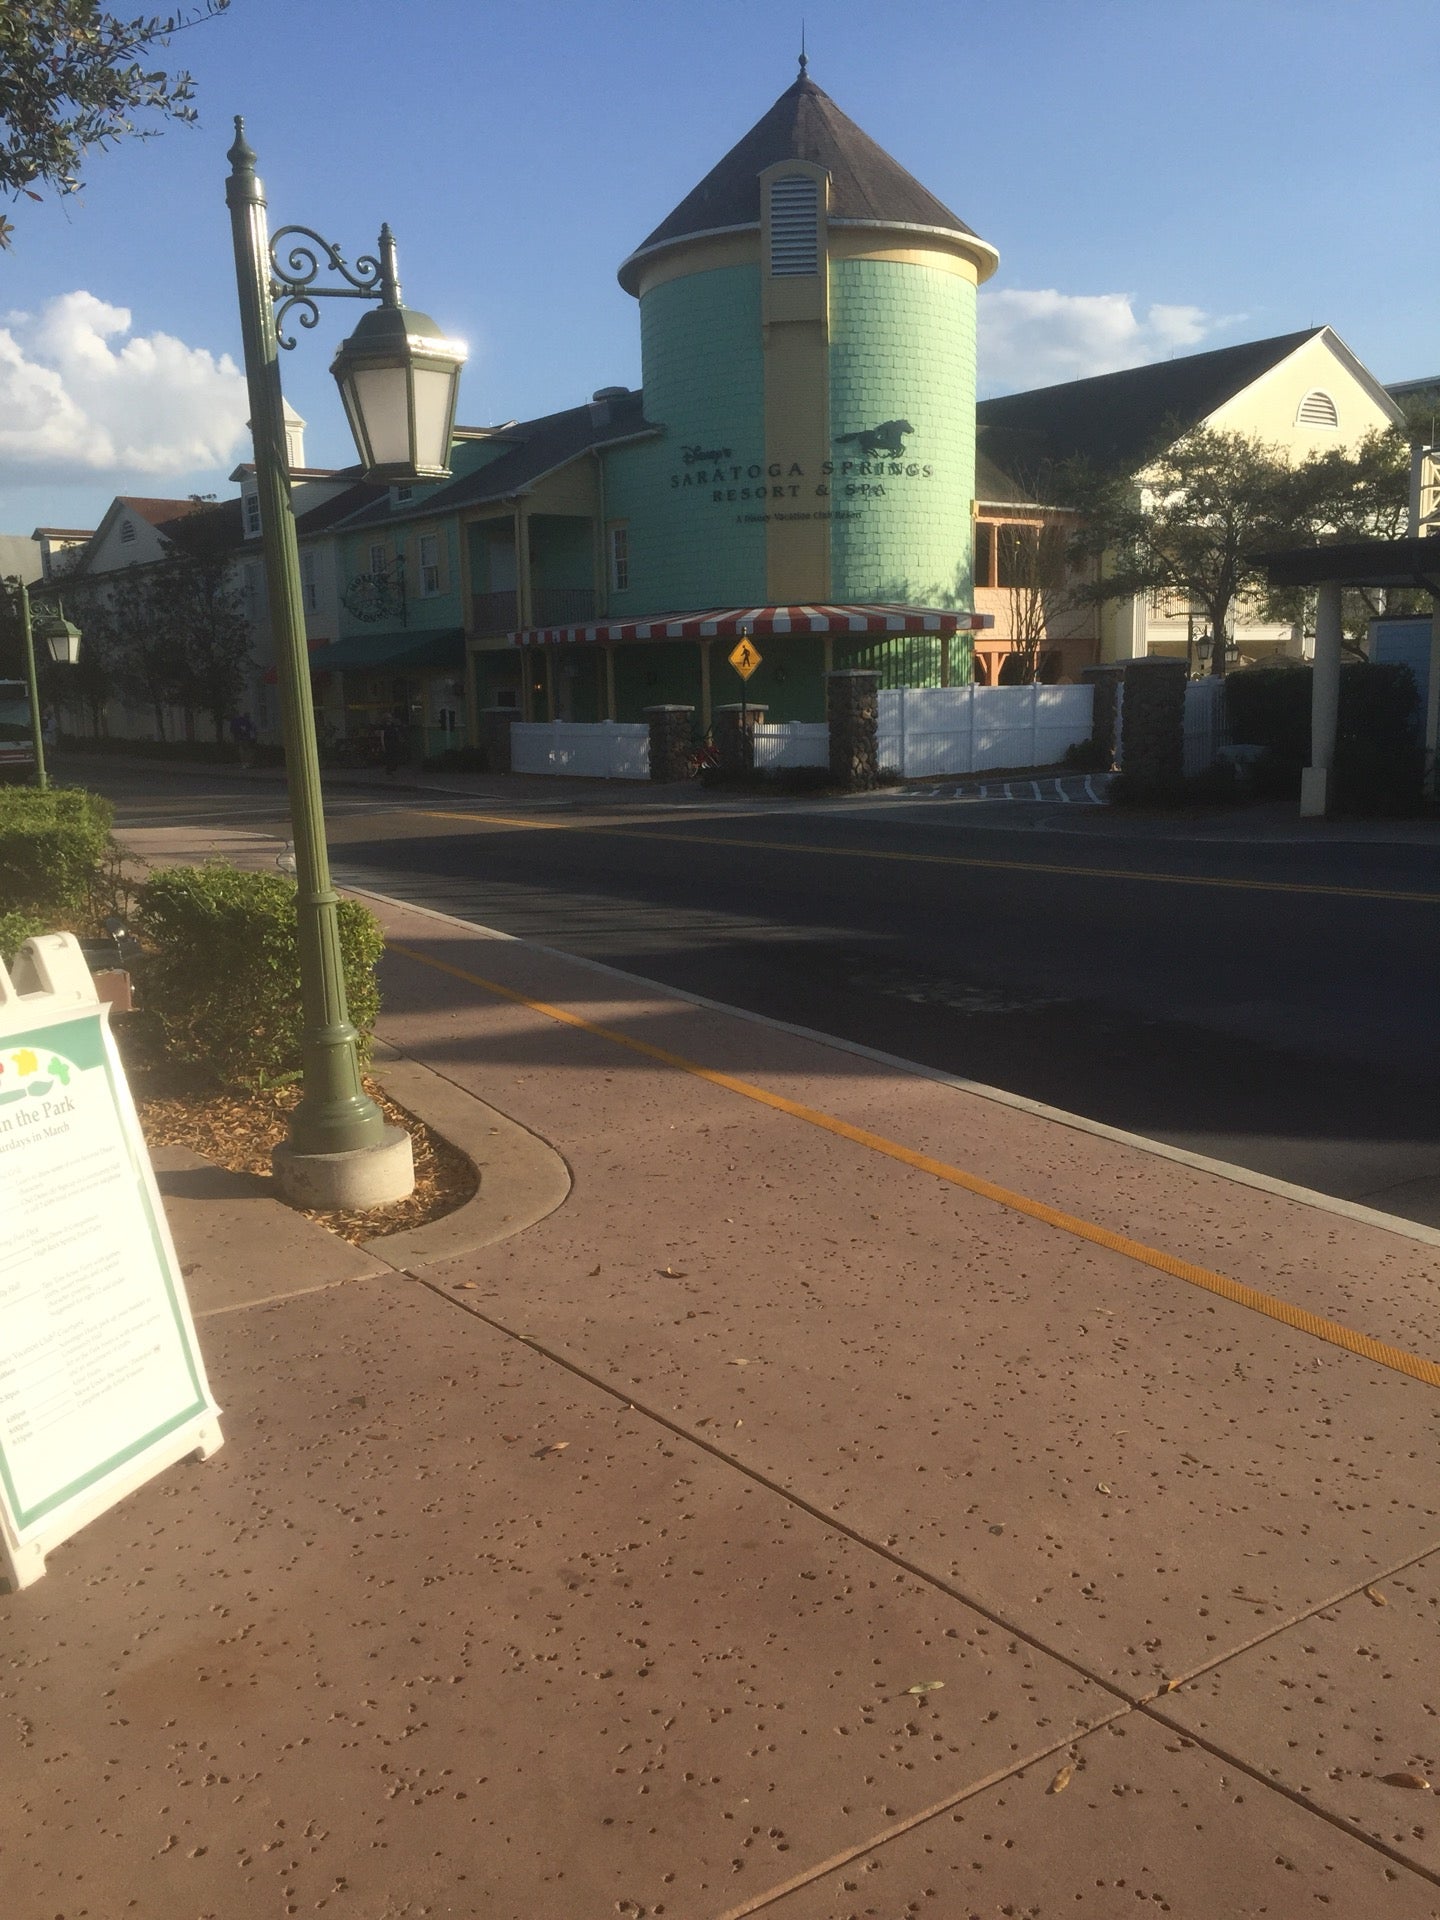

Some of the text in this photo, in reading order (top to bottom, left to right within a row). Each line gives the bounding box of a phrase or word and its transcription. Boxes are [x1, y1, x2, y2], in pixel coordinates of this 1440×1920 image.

[671, 461, 934, 489] SARATOGA SPRINGS
[712, 483, 886, 502] RESORT & SPA
[15, 1109, 40, 1127] the
[42, 1095, 75, 1118] Park
[32, 1132, 42, 1143] in
[43, 1121, 70, 1139] March
